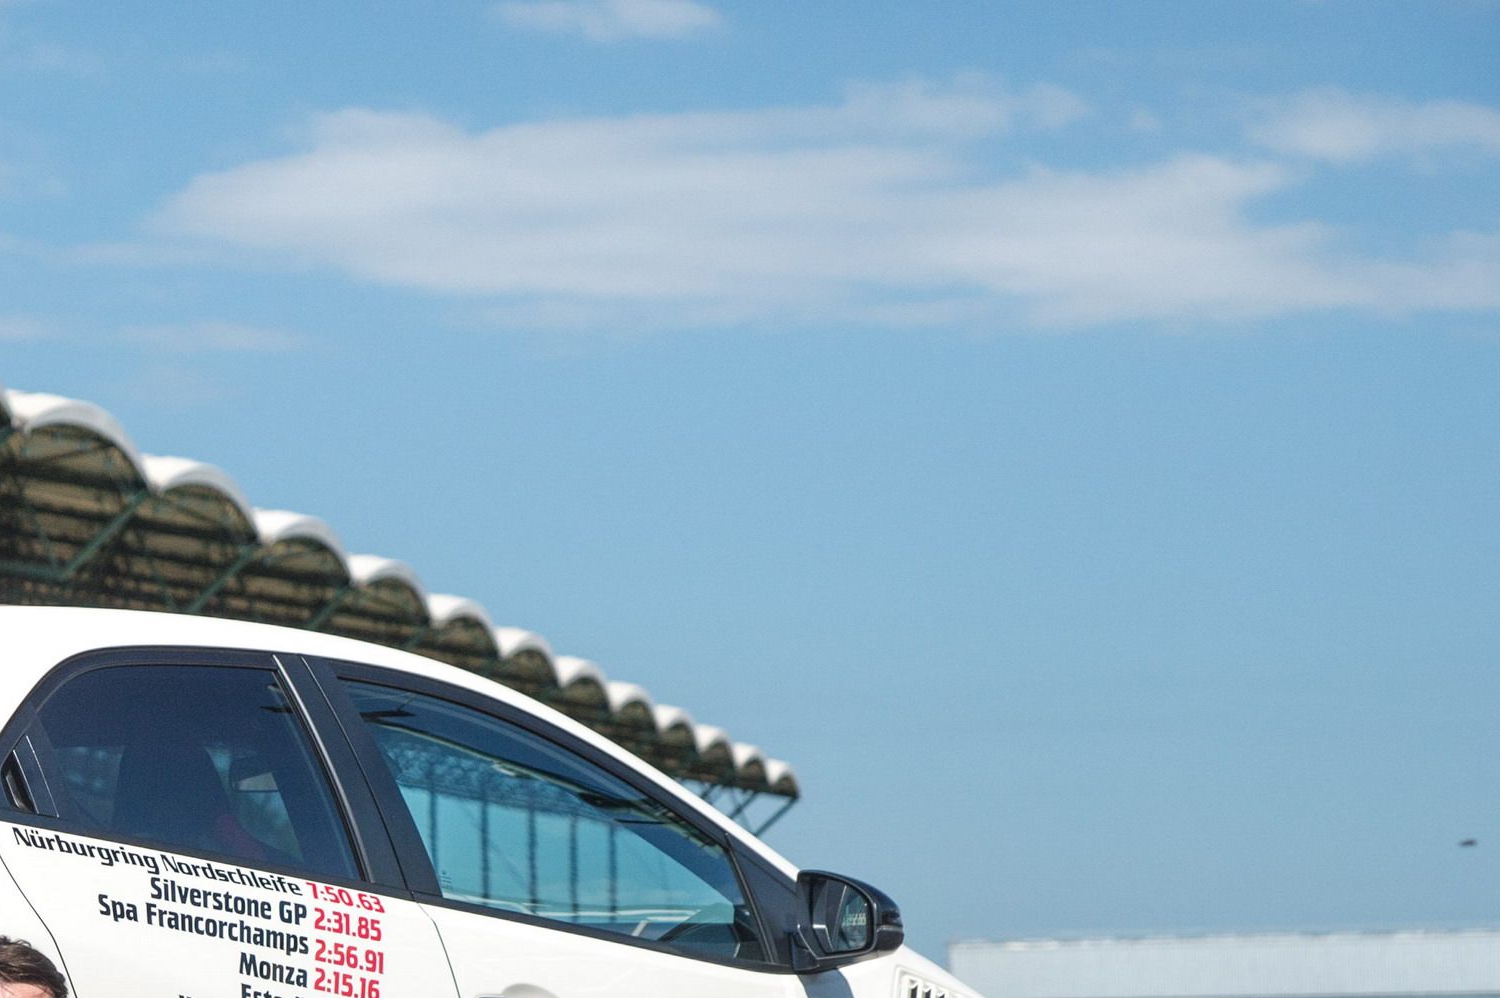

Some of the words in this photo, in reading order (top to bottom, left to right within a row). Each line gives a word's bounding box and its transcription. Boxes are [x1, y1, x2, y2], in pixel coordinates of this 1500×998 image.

[12, 827, 161, 875] Nürburgring
[162, 854, 304, 897] Nordschleife
[306, 882, 386, 914] 7:50.63
[98, 894, 139, 924] Spa
[146, 903, 310, 956] Francorchamps
[315, 939, 384, 975] 2:56.91
[150, 877, 272, 921] Silverstone
[278, 900, 308, 926] GP
[313, 908, 382, 943] 2:31.85
[239, 952, 308, 989] Monza
